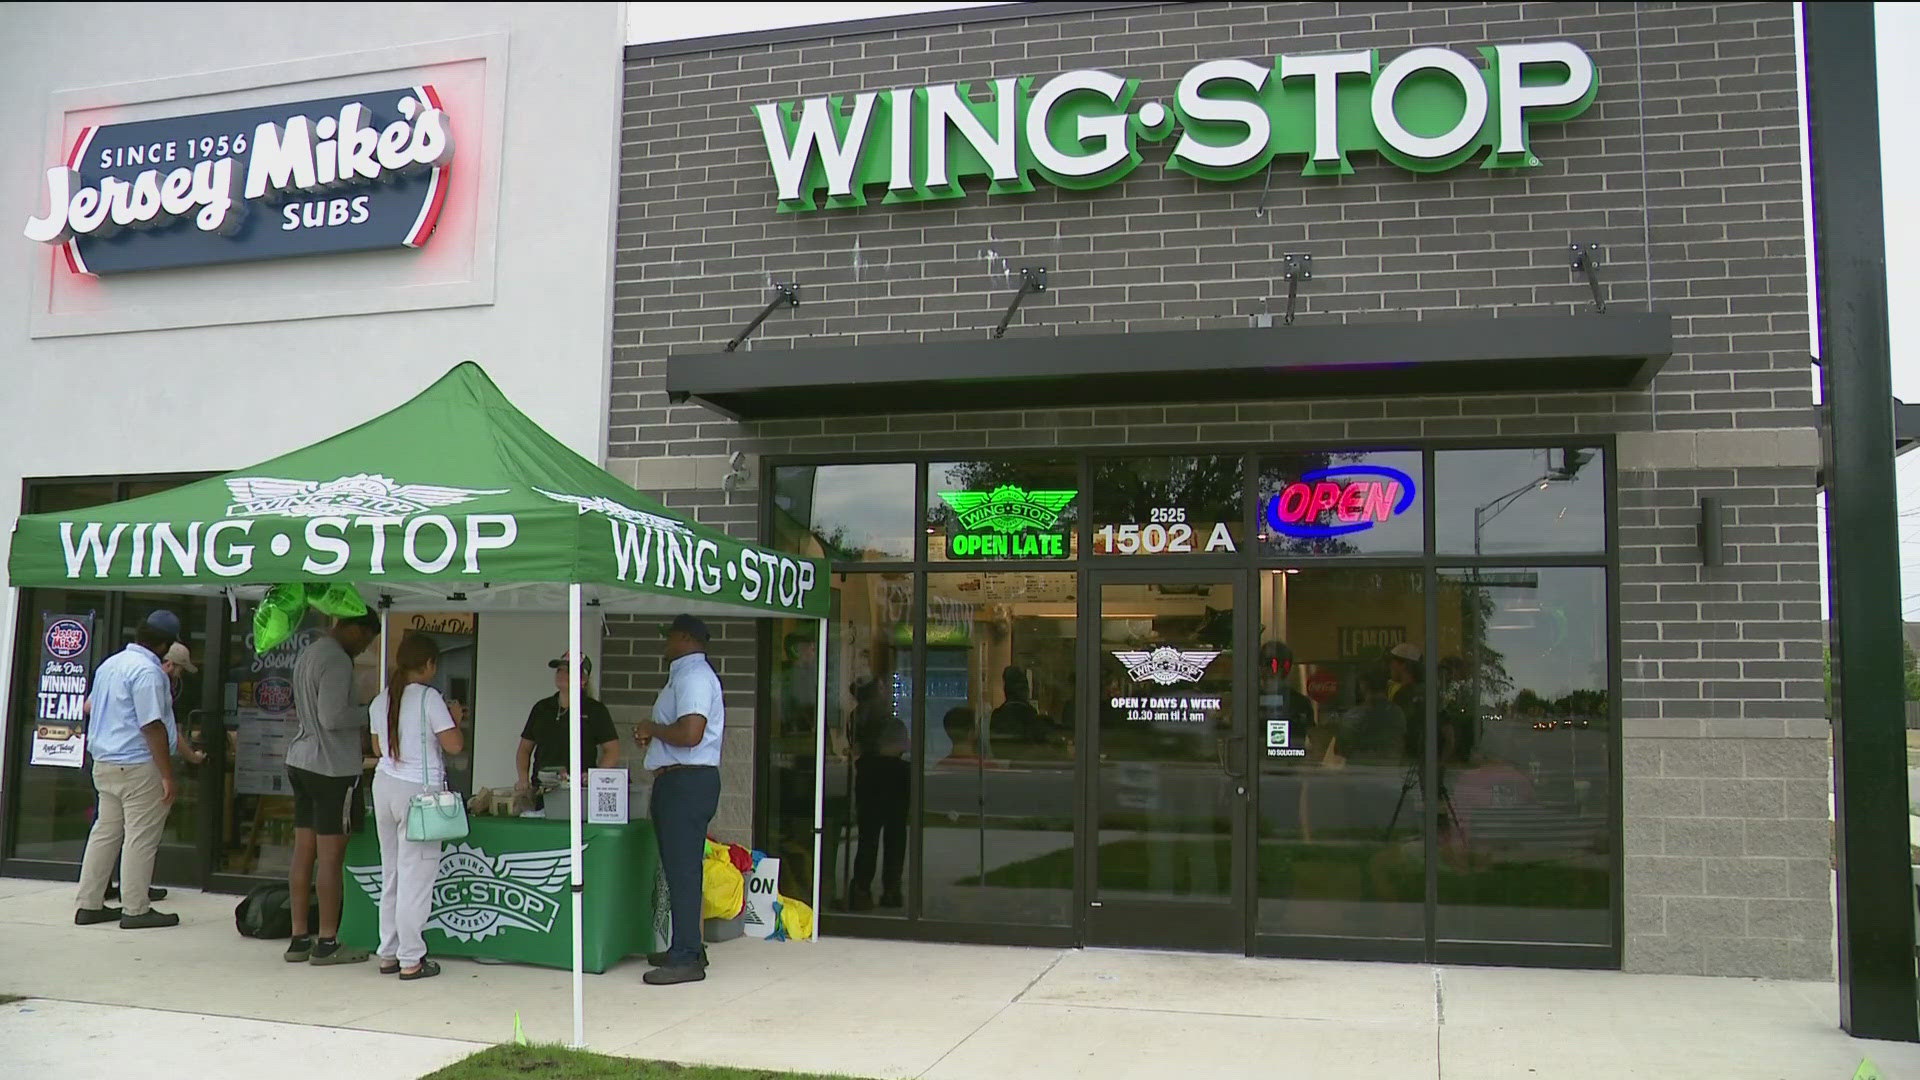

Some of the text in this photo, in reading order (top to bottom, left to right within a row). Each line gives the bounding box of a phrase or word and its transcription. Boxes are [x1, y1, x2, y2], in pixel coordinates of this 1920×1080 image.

[100, 133, 248, 168] SINCE 1956
[24, 96, 450, 243] Jersey Mike's
[281, 196, 370, 231] SUBS
[1278, 482, 1400, 522] OPEN
[1150, 508, 1186, 523] 2525
[953, 534, 1063, 555] OPEN LATE
[1098, 522, 1236, 554] 1502 A
[45, 661, 84, 675] Join Our
[41, 675, 87, 694] WINNING
[38, 692, 85, 720] TEAM
[1111, 698, 1220, 710] OPEN 7 DAYS A WEEK
[1154, 712, 1168, 721] am
[1189, 712, 1204, 722] am
[440, 857, 485, 875] THE WING
[749, 878, 775, 895] ON
[447, 912, 490, 928] EXPERTS
